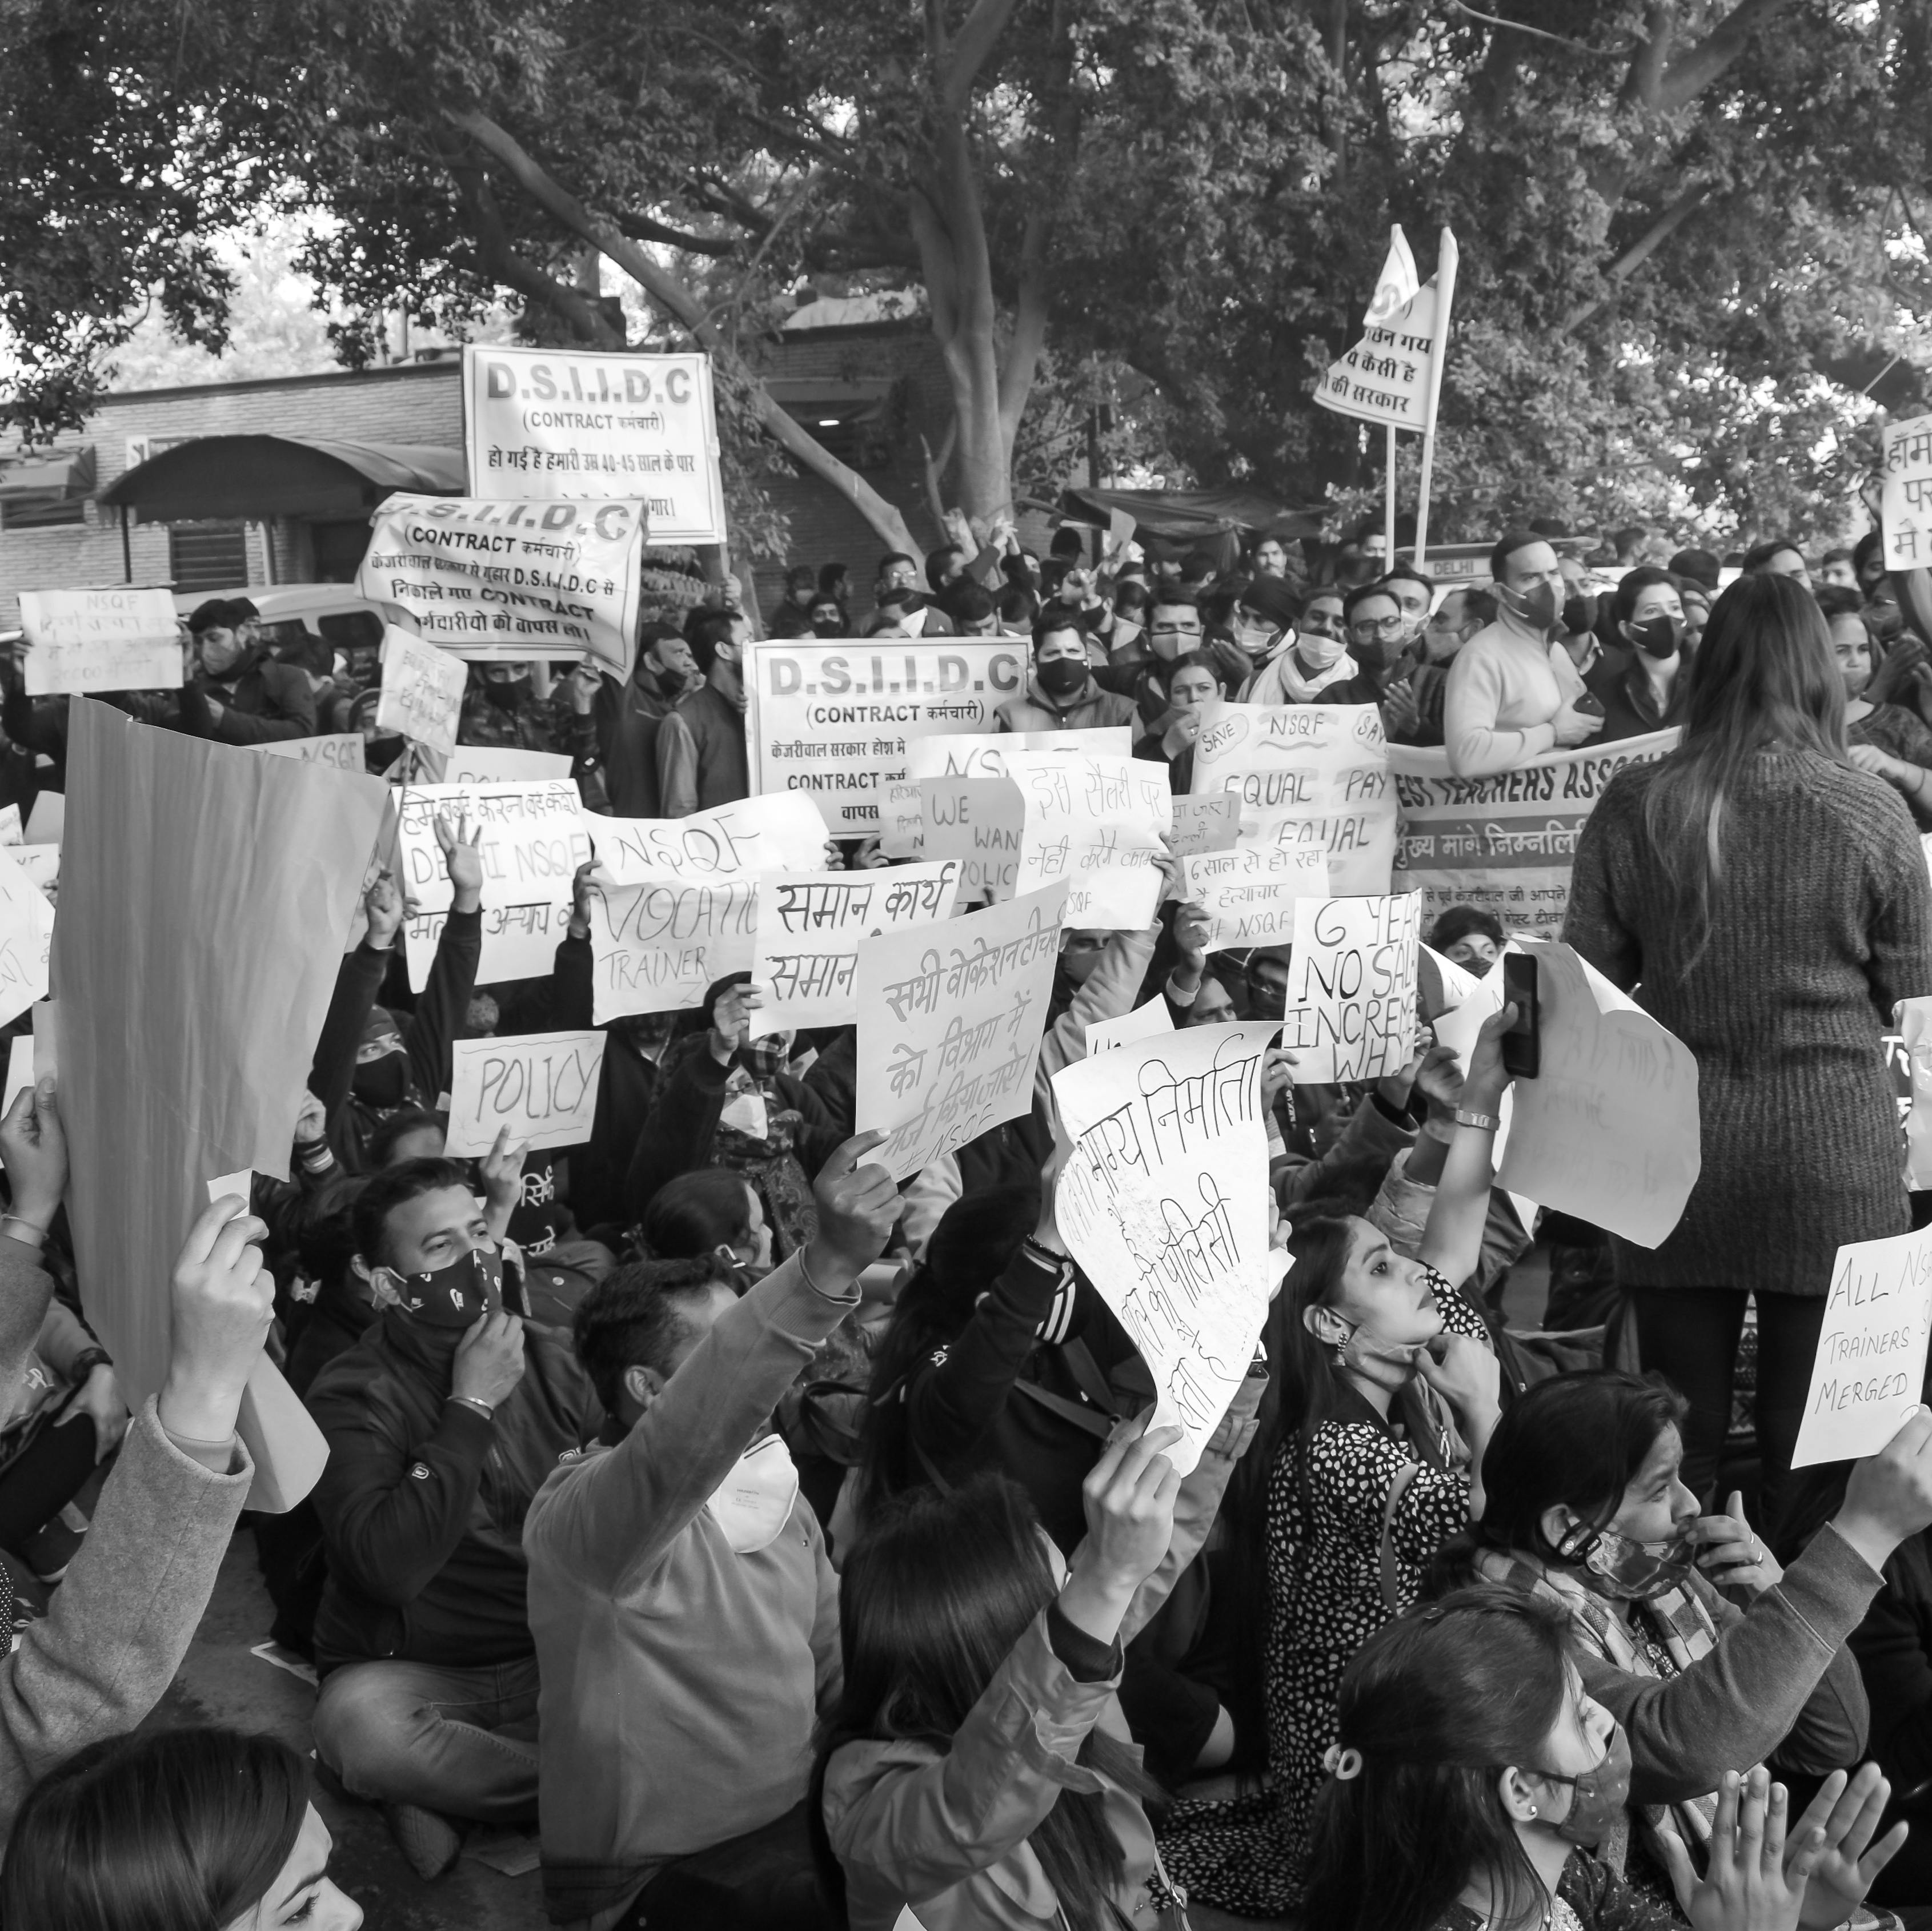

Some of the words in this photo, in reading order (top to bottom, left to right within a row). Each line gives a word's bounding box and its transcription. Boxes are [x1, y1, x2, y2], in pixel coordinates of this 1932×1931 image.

[487, 362, 692, 404] D.S.I.I.D.C
[523, 410, 613, 433] (CONTRACT
[488, 445, 502, 468] हो
[546, 448, 580, 471] हमारी
[677, 455, 695, 472] पार
[404, 524, 516, 553] (CONTRACT
[86, 593, 139, 611] NSQF
[480, 589, 594, 621] CONTRACT
[769, 654, 1020, 696] D.S.I.I.D.C
[805, 702, 921, 730] (CONTRACT
[1201, 723, 1236, 754] SAVE
[1269, 712, 1326, 737] NSQF
[787, 770, 879, 791] CONTRACT
[1344, 770, 1386, 801] PAY
[1394, 773, 1436, 808] EST
[932, 792, 970, 826] WE
[959, 859, 1020, 889] POLIC
[775, 882, 876, 934] समान
[885, 861, 956, 923] कार्य
[1068, 891, 1092, 916] SQF
[764, 953, 857, 1001] समान
[1297, 949, 1363, 1004] NO
[475, 1048, 603, 1125] POLICY
[885, 1042, 928, 1099] को
[1829, 1256, 1890, 1311] ALL
[1823, 1325, 1911, 1366] TRAINERS
[1814, 1372, 1909, 1416] MERGED
